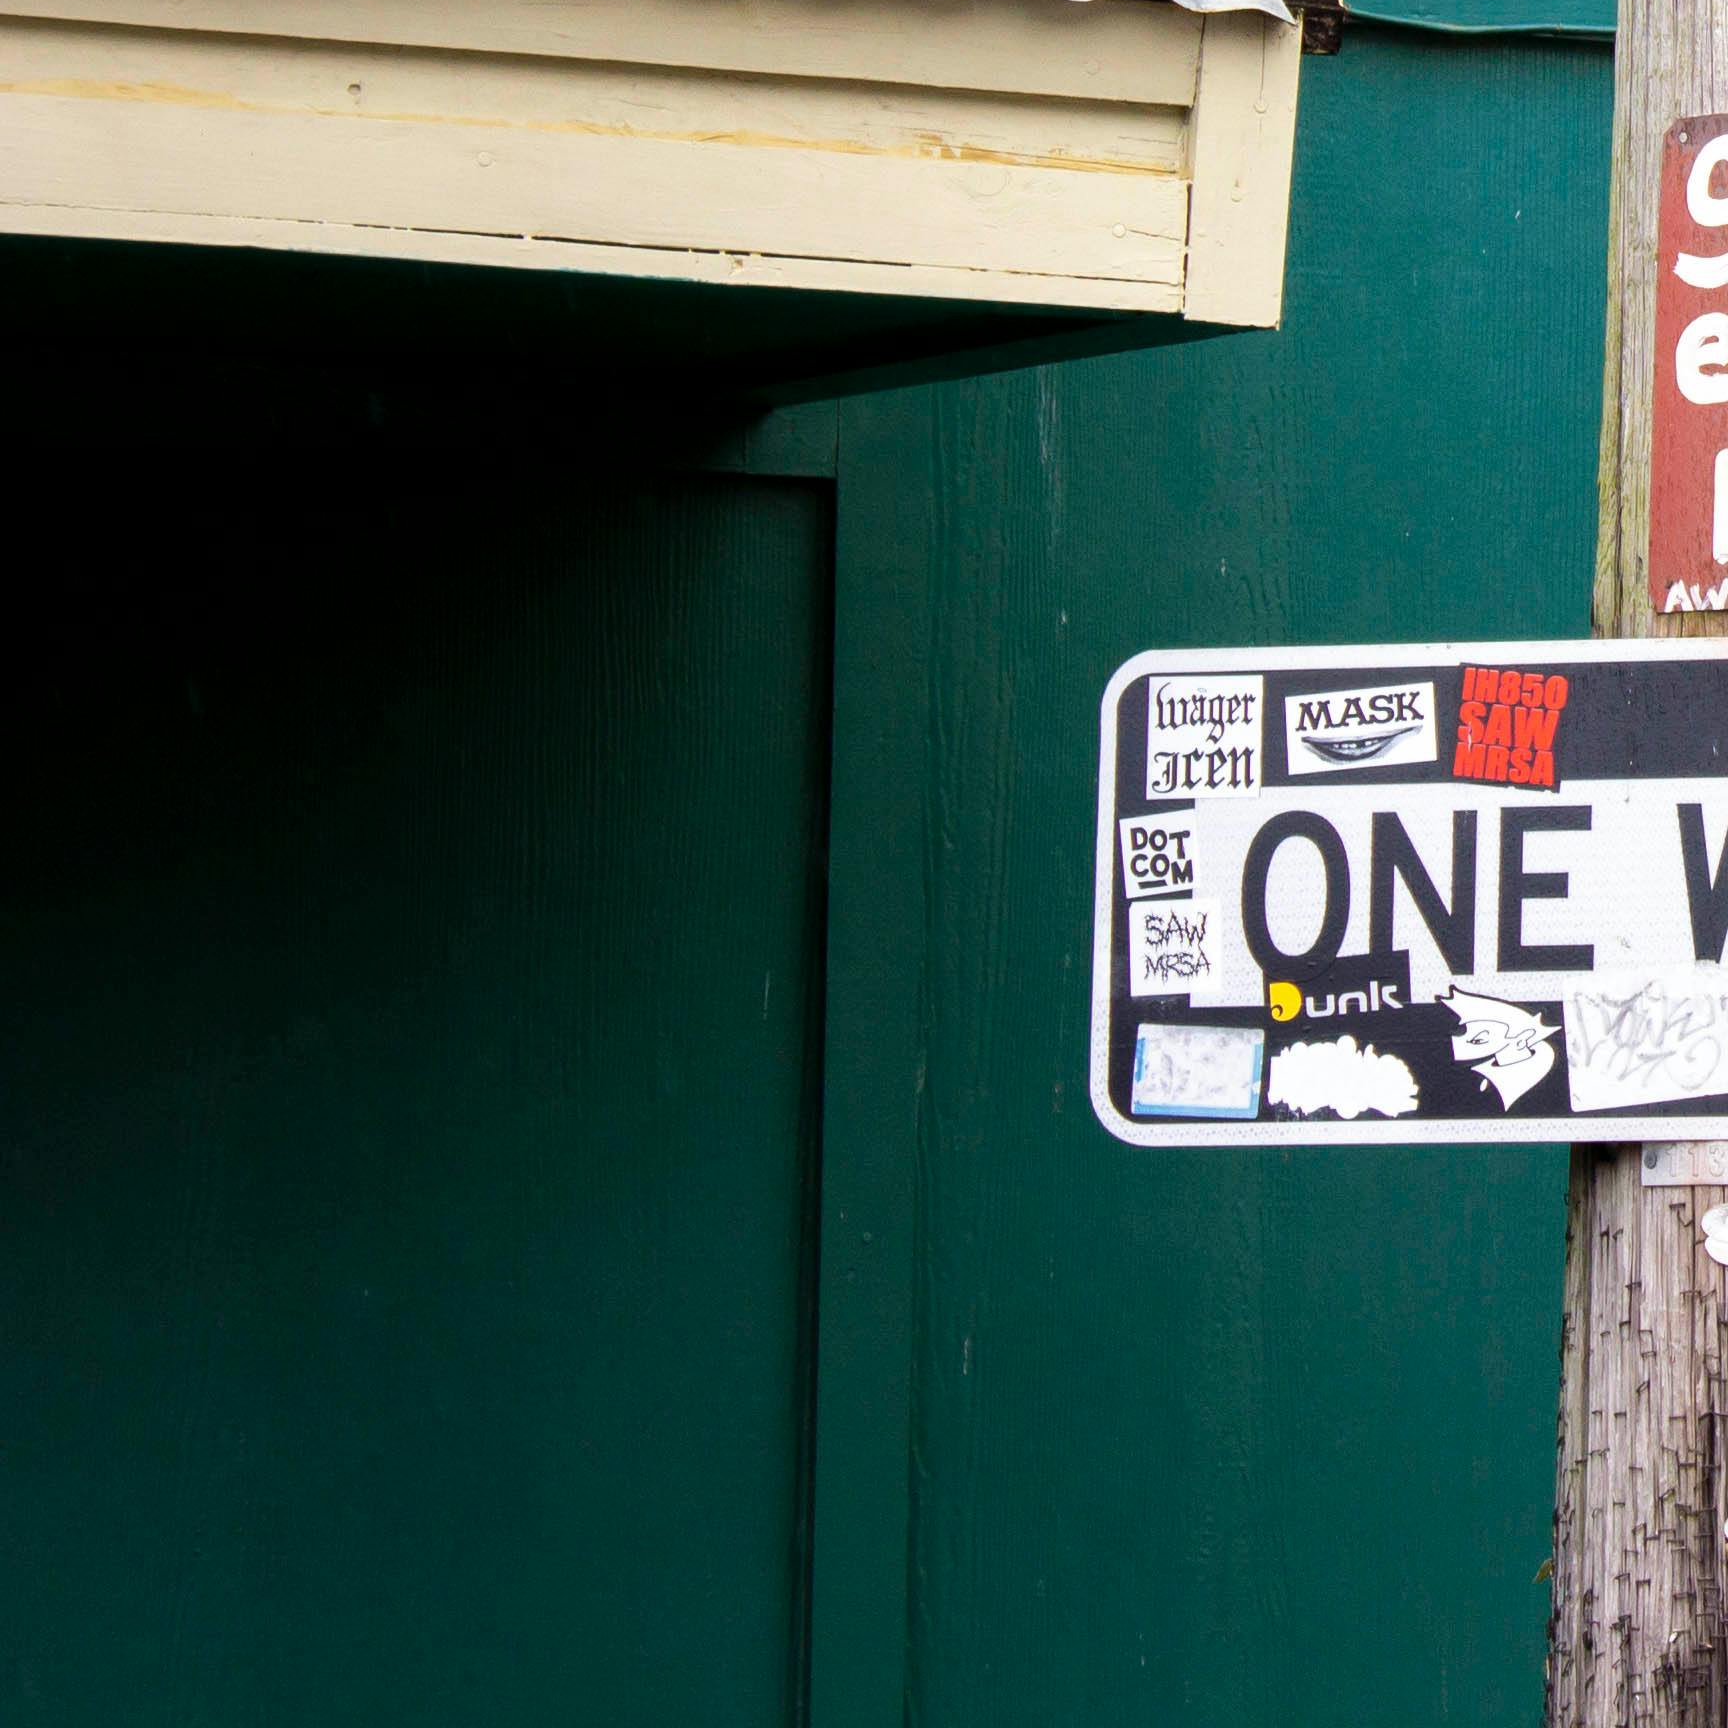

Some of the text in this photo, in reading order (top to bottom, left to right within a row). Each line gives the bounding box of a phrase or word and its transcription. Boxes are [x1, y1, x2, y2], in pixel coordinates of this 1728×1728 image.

[1295, 691, 1424, 732] MASK
[1457, 701, 1560, 751] SAW
[1453, 742, 1554, 787] MRSA
[1130, 827, 1191, 859] DOT
[1130, 853, 1193, 885] COM
[1241, 804, 1595, 979] ONE
[1144, 909, 1208, 949] SAW
[1144, 949, 1212, 984] MRSA
